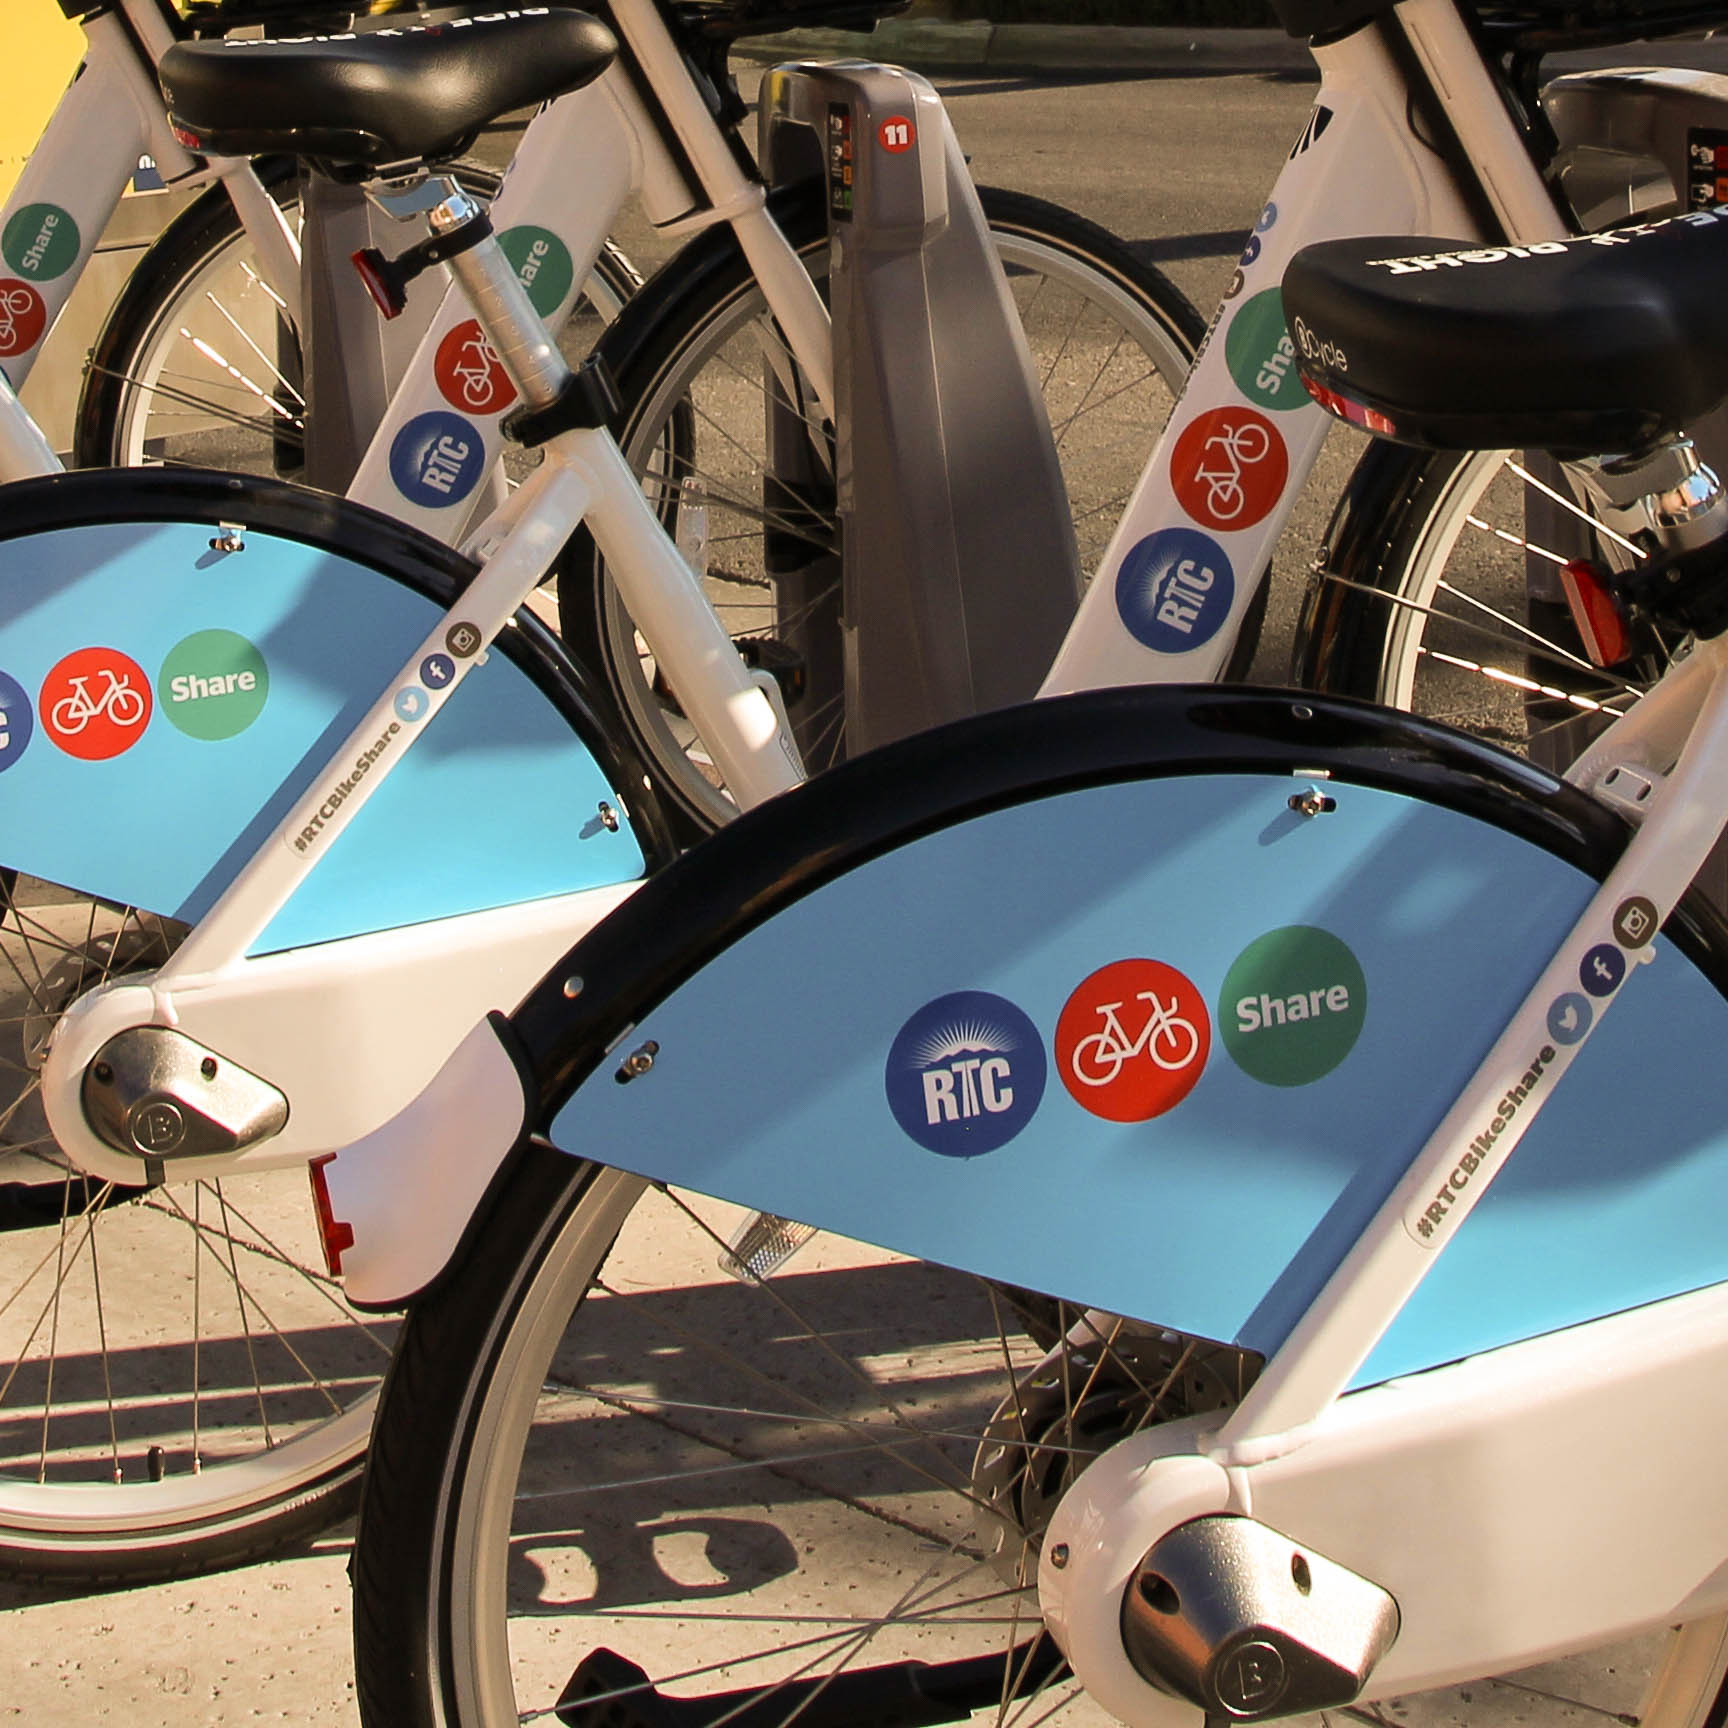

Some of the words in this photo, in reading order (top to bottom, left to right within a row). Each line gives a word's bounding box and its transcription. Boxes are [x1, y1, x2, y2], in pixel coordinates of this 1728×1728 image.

[884, 124, 909, 146] 11
[21, 214, 60, 272] Share
[1256, 327, 1297, 396] Sha
[421, 435, 470, 494] RTC
[1155, 558, 1216, 634] RTC
[170, 668, 257, 703] Share
[292, 719, 404, 855] #RTCBikeShare
[921, 1056, 1015, 1126] RTC
[1235, 980, 1351, 1035] Share
[1415, 1042, 1558, 1240] #RTCBikeShare
